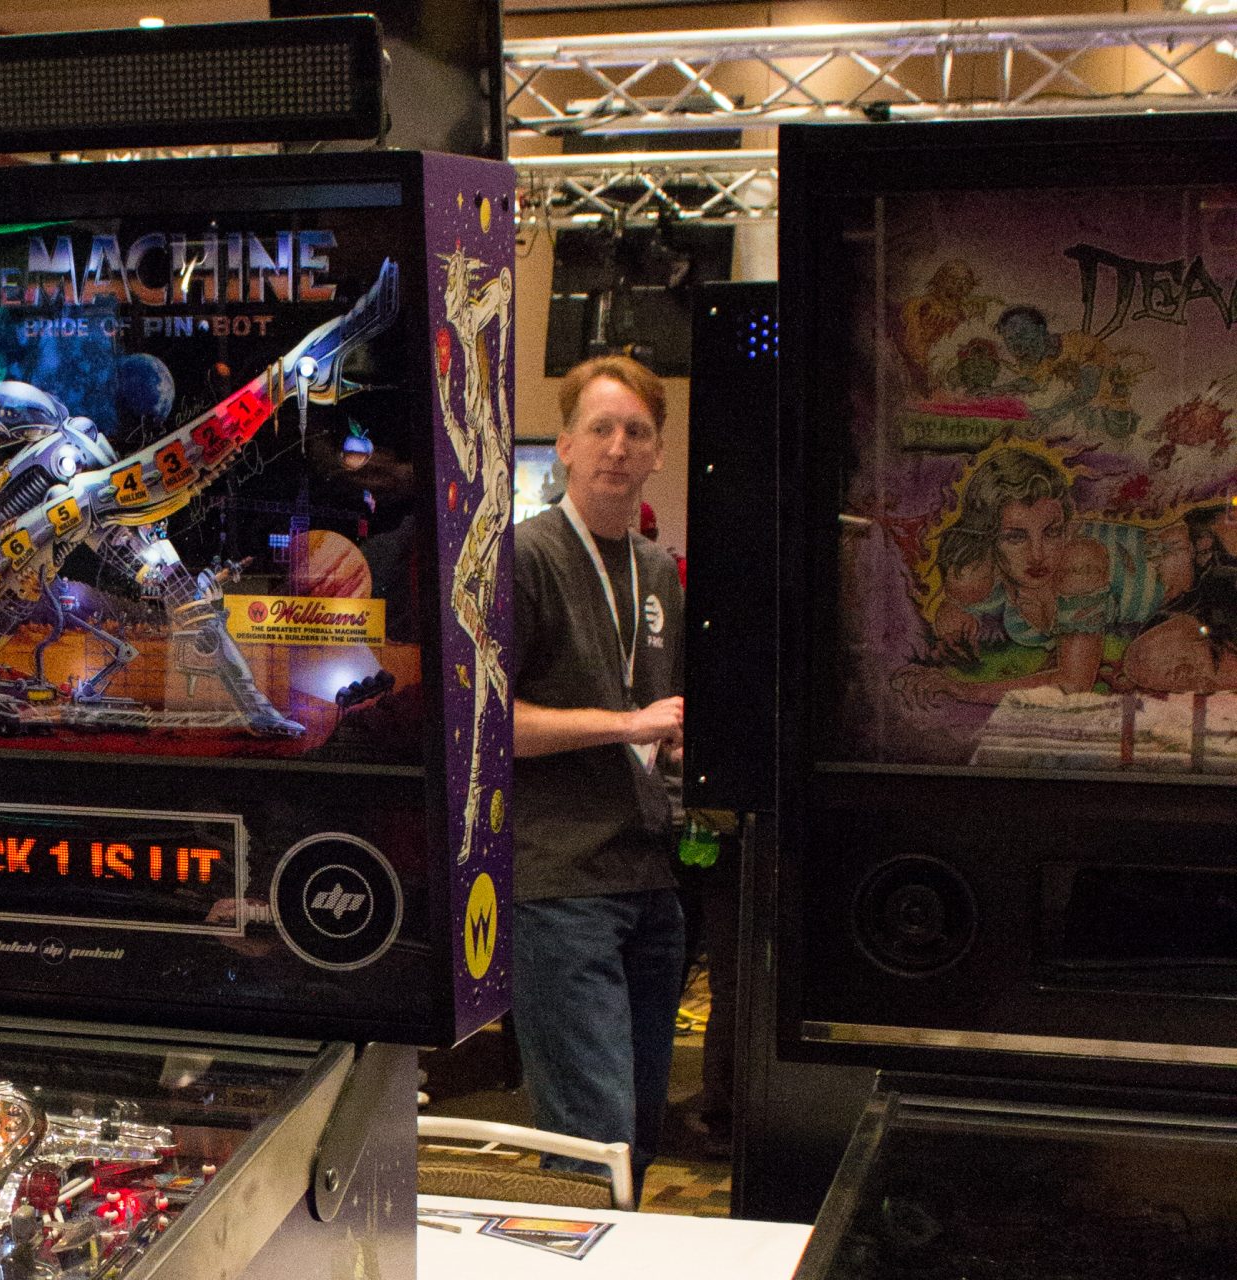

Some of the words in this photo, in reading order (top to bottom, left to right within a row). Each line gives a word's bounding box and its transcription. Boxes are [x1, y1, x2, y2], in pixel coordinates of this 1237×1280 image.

[26, 230, 338, 306] MACHINE
[24, 317, 89, 338] BRIDE
[102, 317, 133, 338] OF
[238, 401, 250, 413] 1
[202, 426, 216, 445] 2
[164, 452, 181, 474] 3
[123, 473, 138, 492] 4
[57, 505, 70, 521] 5
[10, 538, 24, 556] 6
[270, 600, 370, 626] Williams
[236, 632, 276, 640] DESIGNERS
[346, 636, 382, 644] UNIVERSE
[266, 626, 301, 634] GREATEST
[304, 627, 332, 635] PINBALL
[335, 628, 367, 636] MACHINE
[50, 841, 69, 875] 1
[91, 842, 135, 880] IS
[69, 947, 125, 960] pinball
